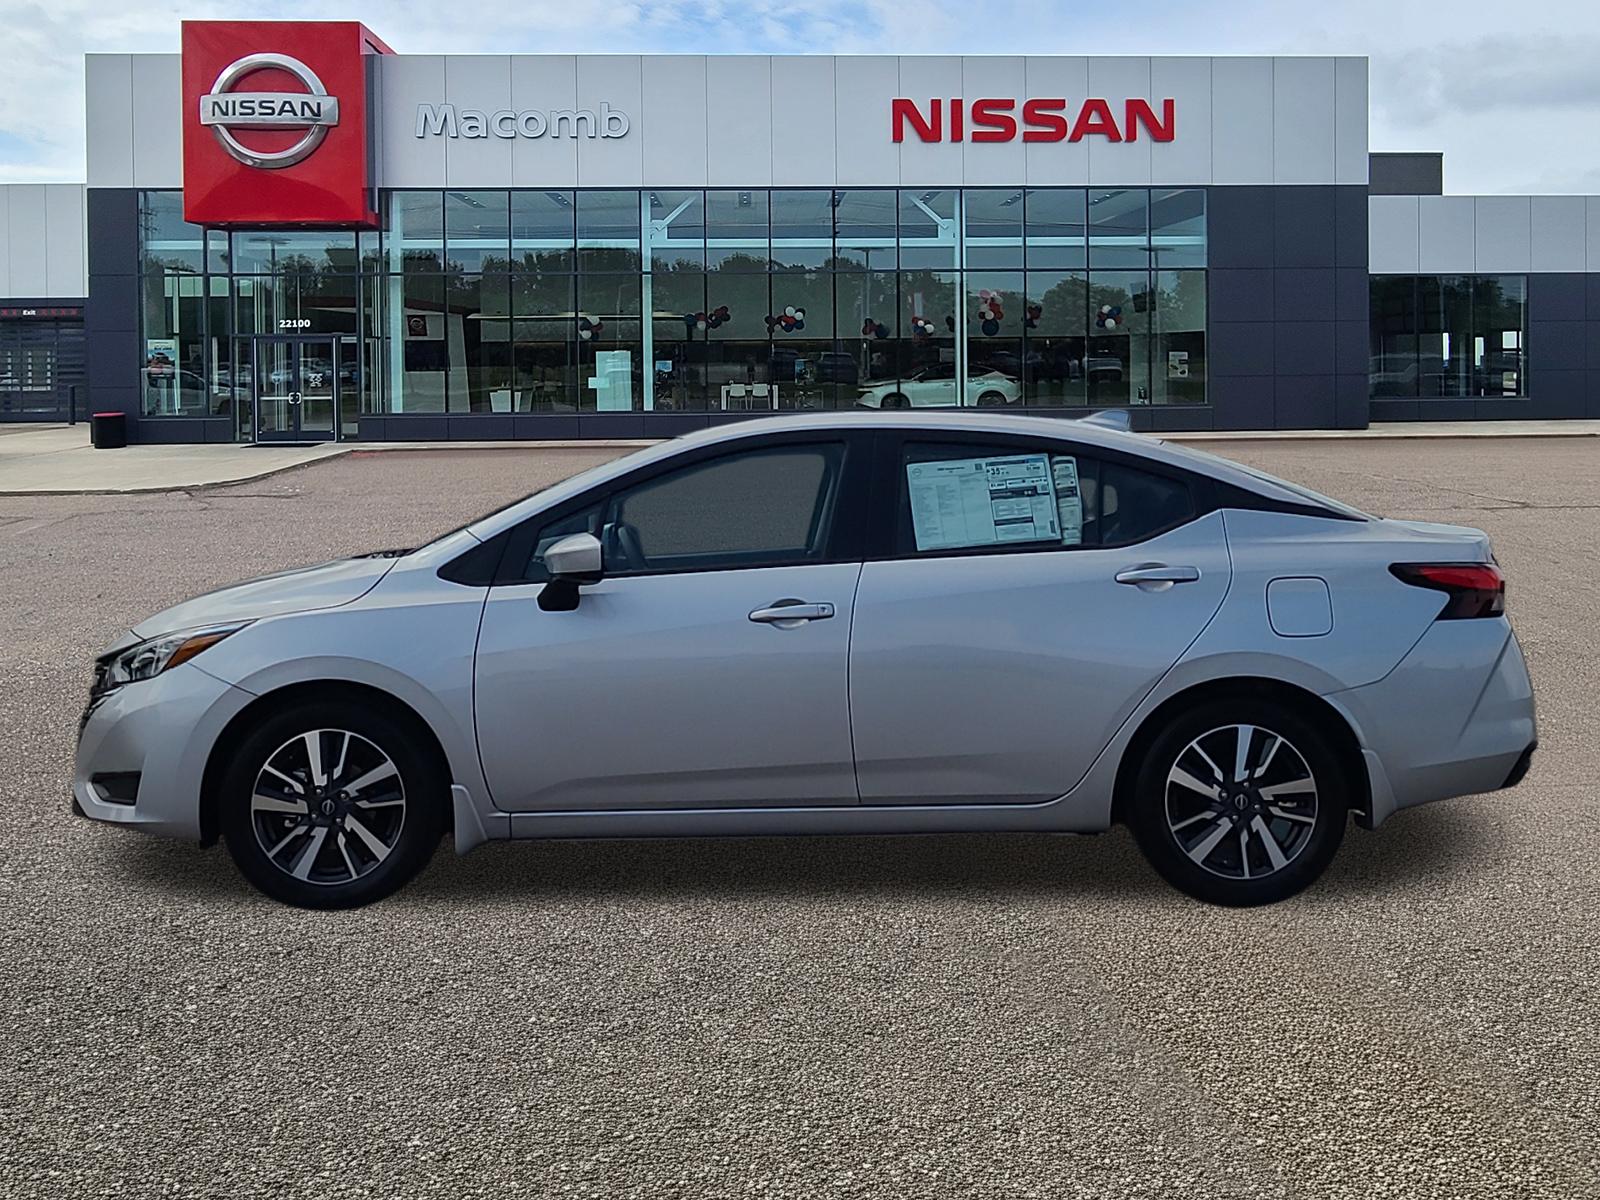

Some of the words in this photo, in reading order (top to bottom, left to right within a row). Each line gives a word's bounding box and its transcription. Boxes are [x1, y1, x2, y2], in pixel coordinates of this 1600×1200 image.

[212, 100, 321, 117] NISSAN
[415, 101, 630, 139] Macomb
[892, 98, 1175, 143] NISSAN
[279, 319, 311, 328] 22100
